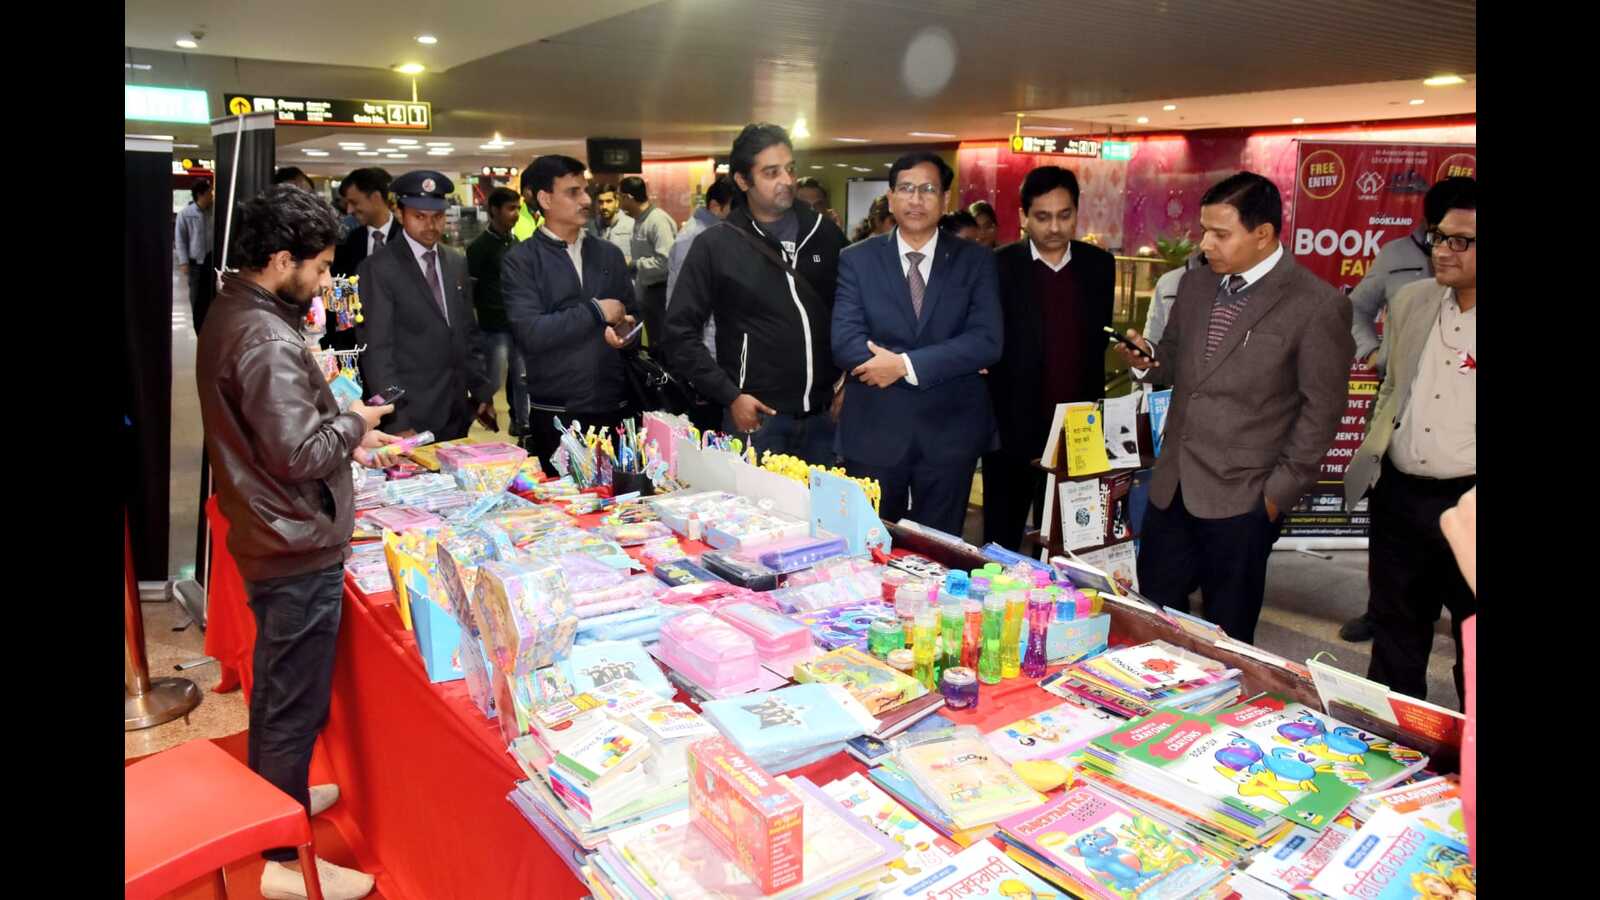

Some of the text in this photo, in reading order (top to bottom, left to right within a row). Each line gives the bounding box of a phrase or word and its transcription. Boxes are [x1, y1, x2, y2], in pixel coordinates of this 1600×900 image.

[1311, 162, 1336, 175] FREE
[1448, 165, 1473, 177] FREE
[1308, 175, 1338, 188] ENTRY
[1368, 216, 1413, 226] BOOKLAND
[1294, 228, 1385, 257] BOOK
[1340, 259, 1376, 276] FAI
[1131, 722, 1171, 741] CRAYONS
[1167, 730, 1202, 752] CRAYONS
